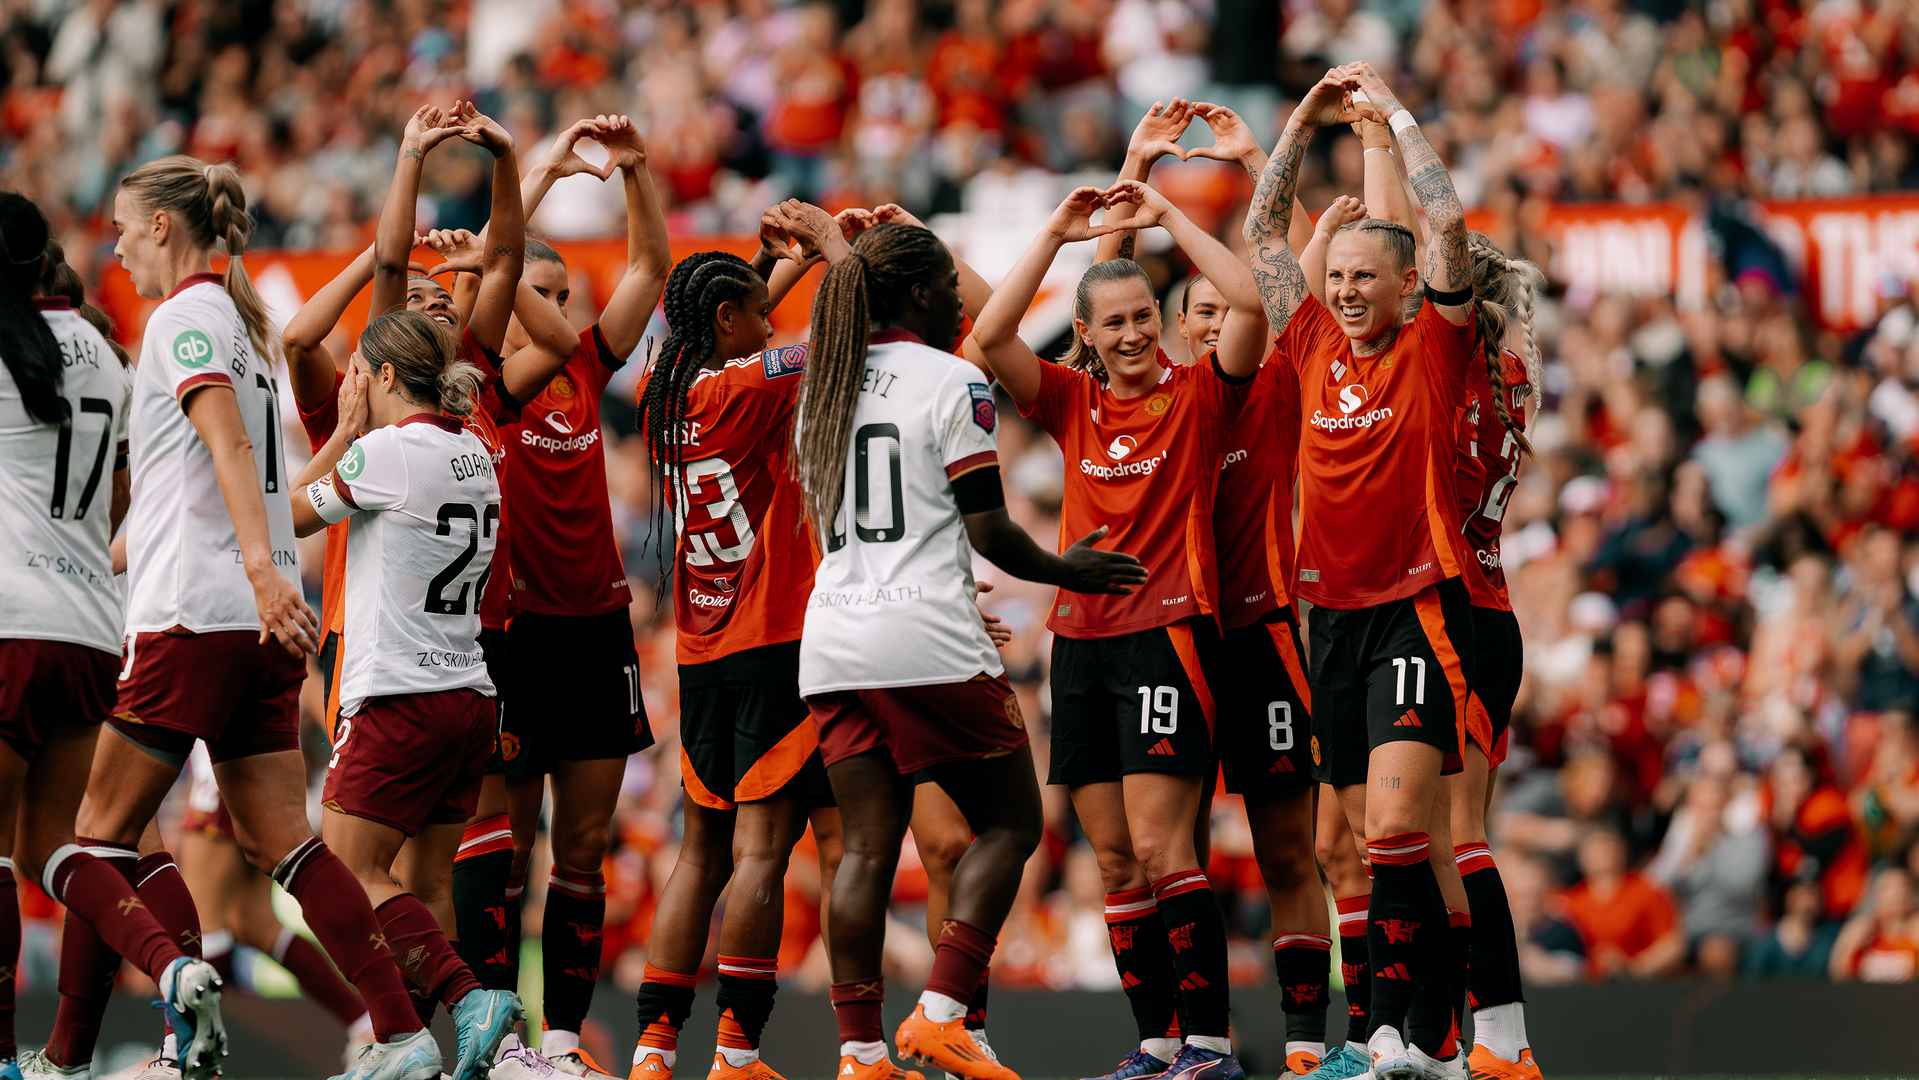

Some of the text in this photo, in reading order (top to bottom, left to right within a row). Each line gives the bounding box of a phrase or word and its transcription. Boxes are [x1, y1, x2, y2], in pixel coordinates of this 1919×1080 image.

[520, 428, 599, 453] Snapdago
[1392, 656, 1426, 706] 11
[1137, 685, 1179, 735] 19
[1267, 700, 1294, 751] 8
